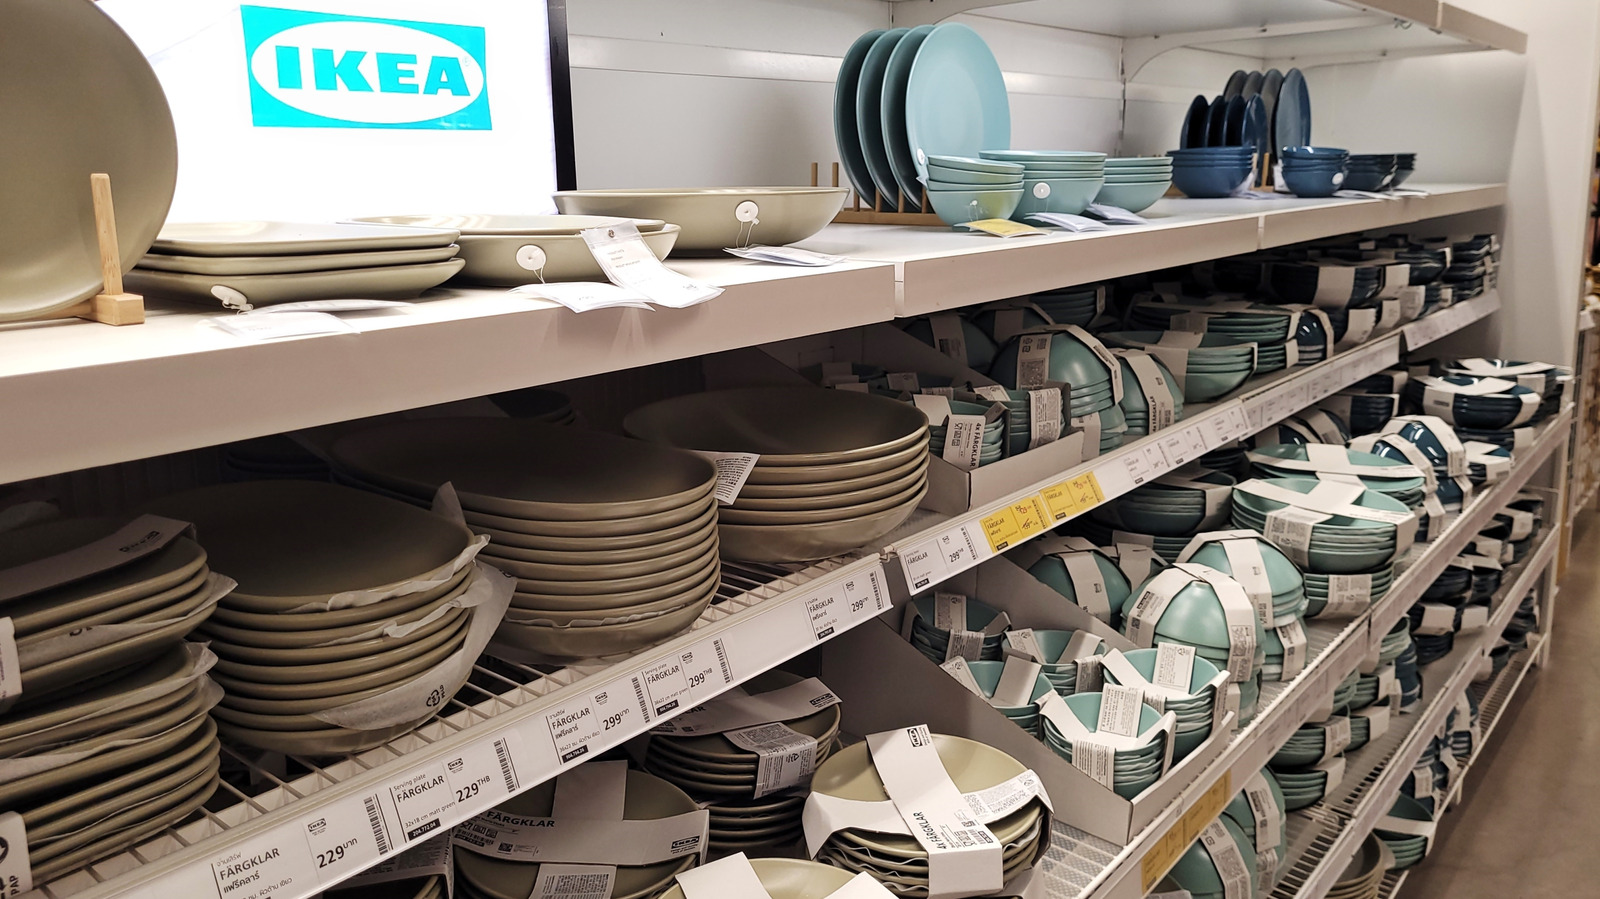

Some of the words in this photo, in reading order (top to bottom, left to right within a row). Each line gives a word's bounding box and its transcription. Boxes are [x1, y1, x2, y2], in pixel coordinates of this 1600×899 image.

[275, 45, 471, 97] IKEA
[976, 422, 982, 430] 4x
[970, 432, 981, 467] FÄRGKLAR
[809, 597, 834, 613] FÄRGKLAR
[648, 665, 680, 684] FÄRGKLAR
[552, 708, 590, 730] FÄRGKLAR
[909, 729, 921, 746] IKEA
[394, 780, 413, 791] Serving
[413, 774, 426, 783] plate
[397, 775, 445, 803] FÄRGKLAR
[309, 820, 325, 830] IKEA
[405, 817, 419, 828] 32x18
[429, 808, 441, 816] matt
[441, 801, 455, 812] green
[487, 811, 555, 828] FÄRGKLAR
[913, 811, 942, 843] FÄRGKLAR
[220, 848, 280, 880] FÄRGKLAR
[9, 875, 20, 896] PAP
